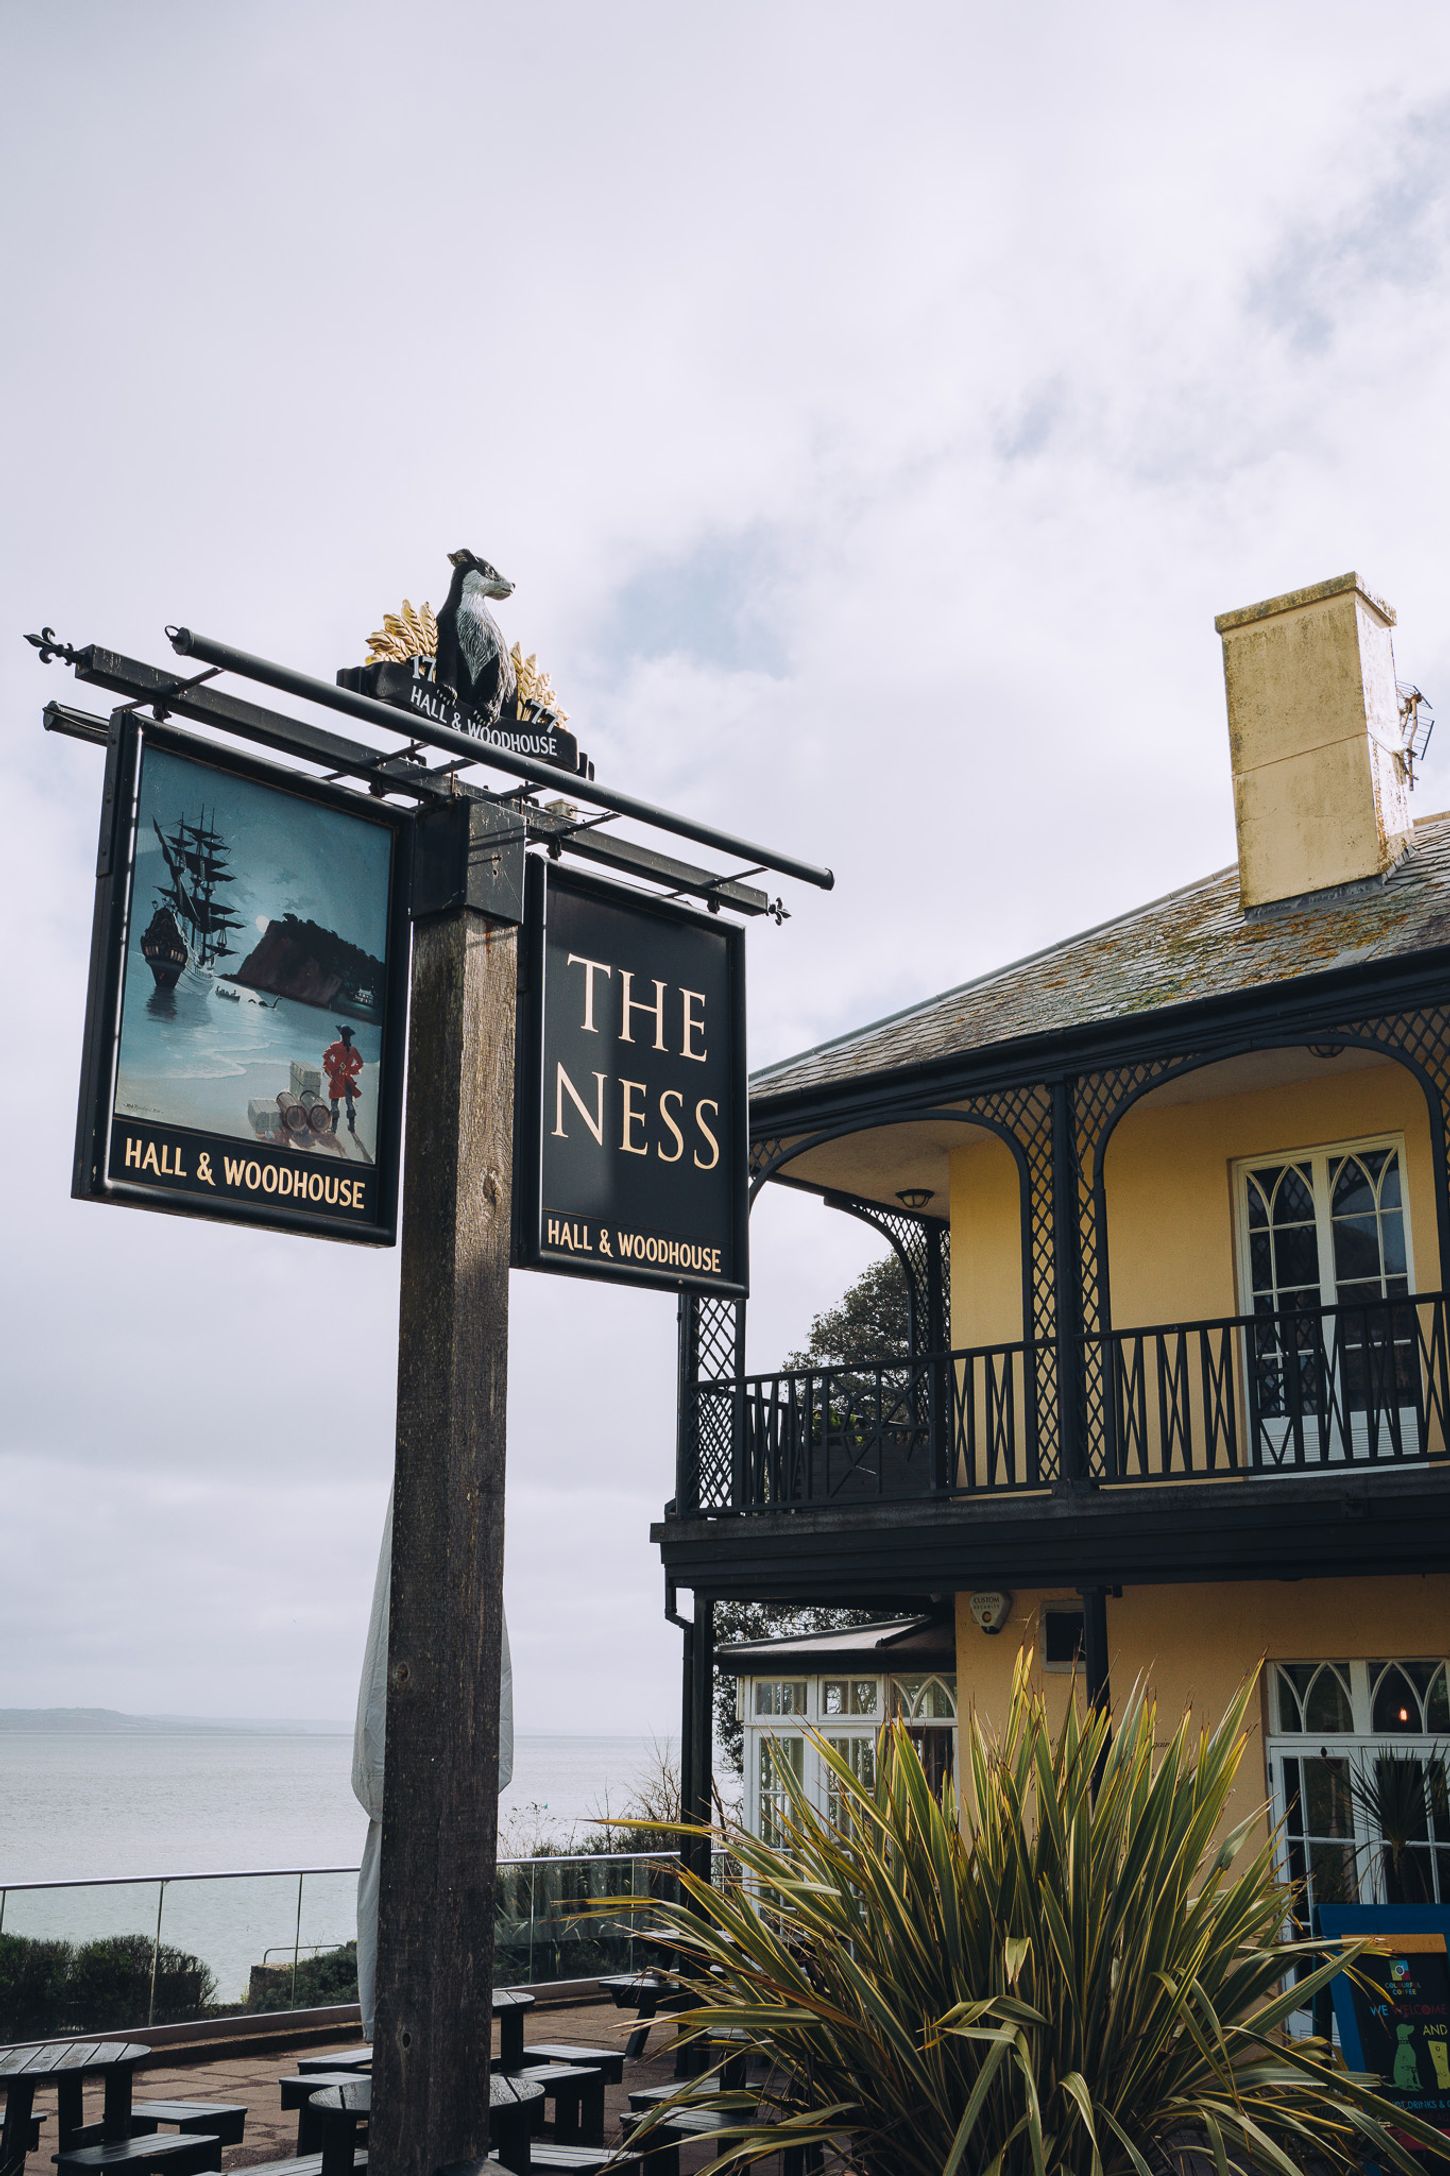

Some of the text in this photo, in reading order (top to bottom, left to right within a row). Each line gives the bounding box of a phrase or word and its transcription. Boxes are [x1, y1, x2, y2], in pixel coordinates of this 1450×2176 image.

[410, 655, 558, 733] 17 77
[410, 685, 558, 756] HALL & WOODHOUSE
[567, 953, 708, 1062] THE
[551, 1061, 720, 1170] NESS
[125, 1137, 366, 1209] HALL & WOODHOUSE
[548, 1219, 722, 1273] HALL & WOODHOUSE
[1369, 2004, 1389, 2016] WE
[1423, 2024, 1448, 2036] AND
